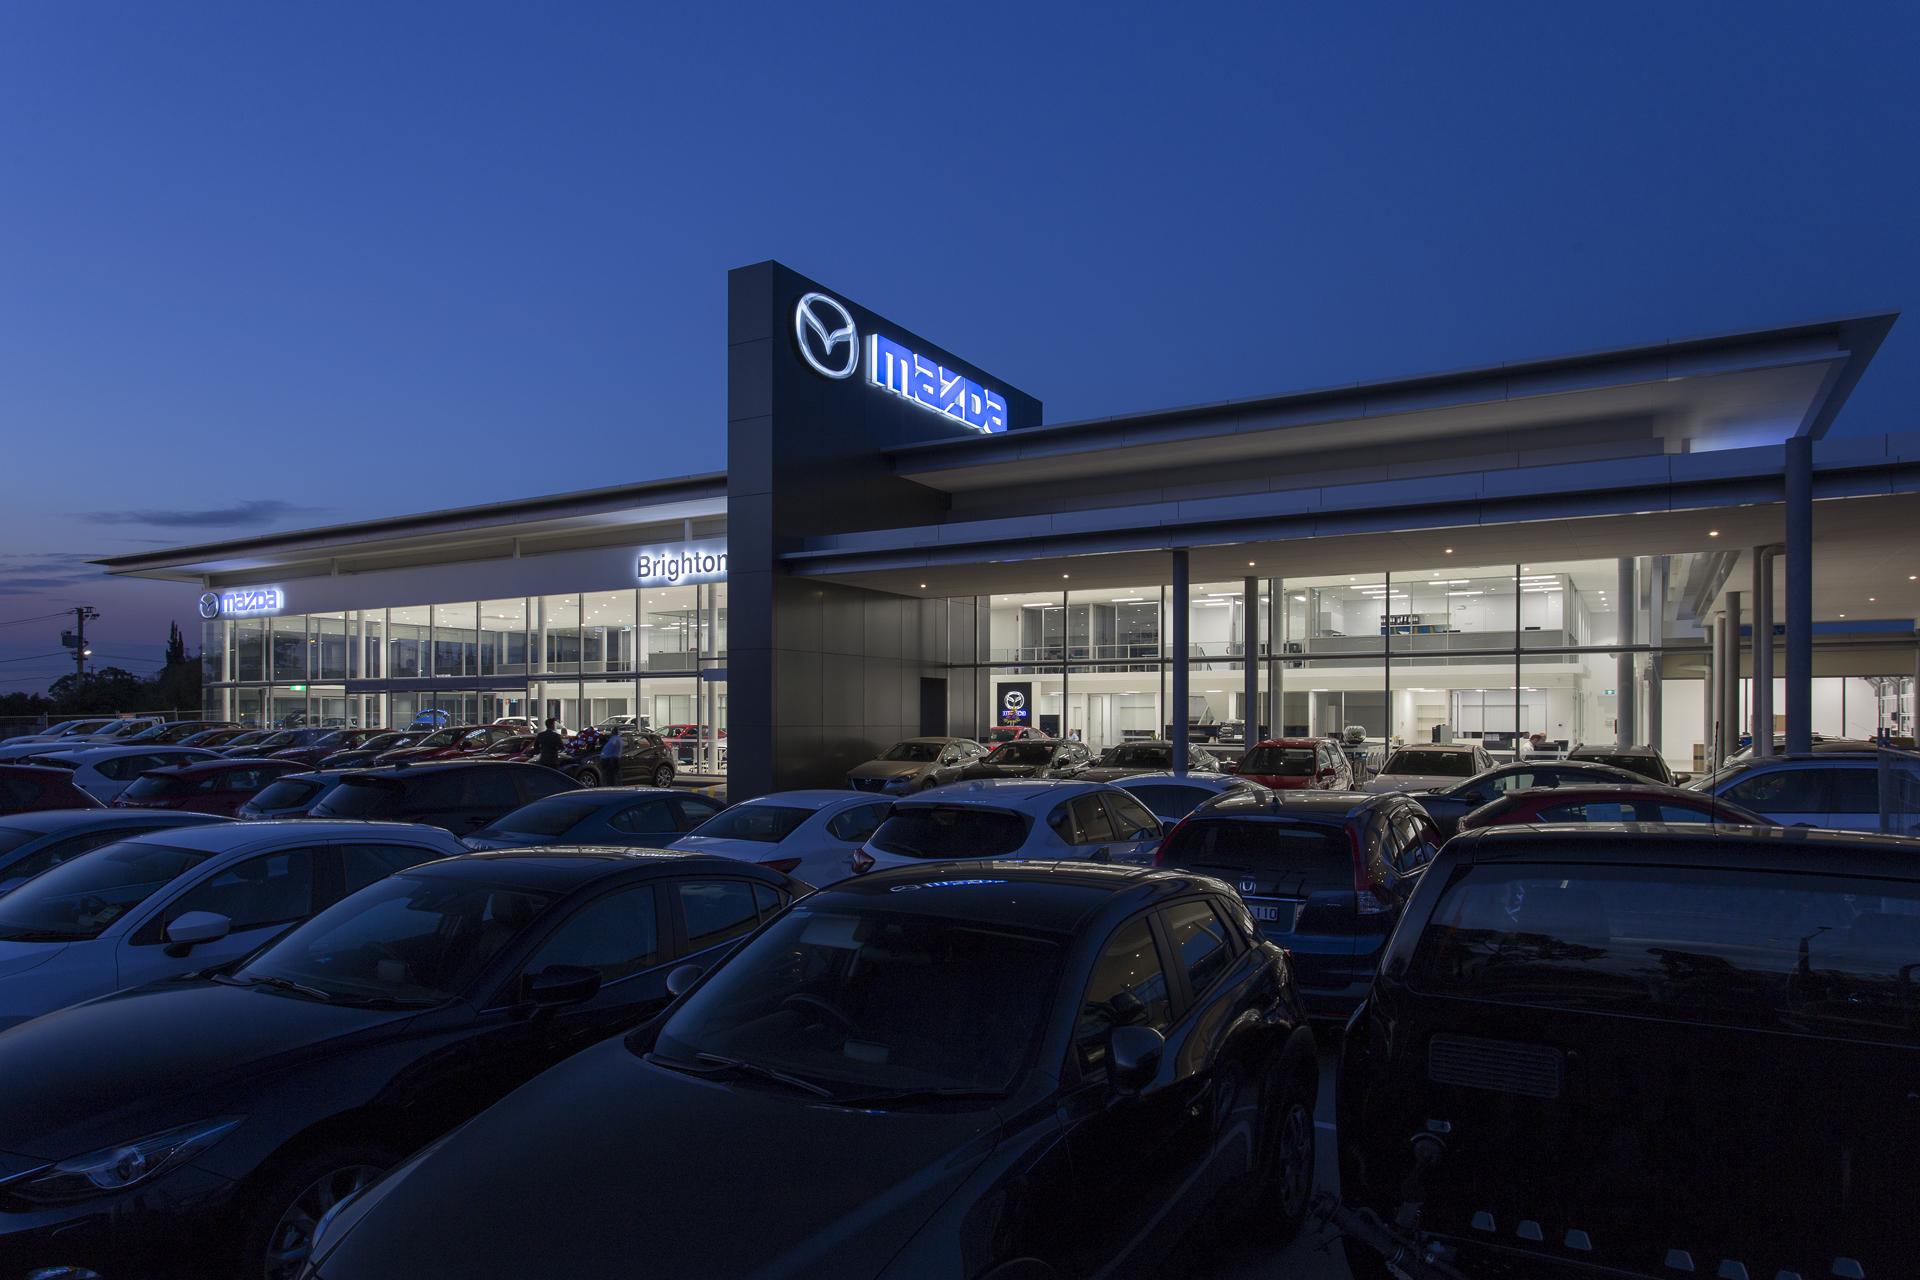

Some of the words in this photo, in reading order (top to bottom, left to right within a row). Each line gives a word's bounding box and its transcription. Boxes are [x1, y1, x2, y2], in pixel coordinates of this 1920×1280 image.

[866, 333, 1008, 434] mazda
[637, 551, 728, 582] Brighton
[221, 590, 284, 613] mazda
